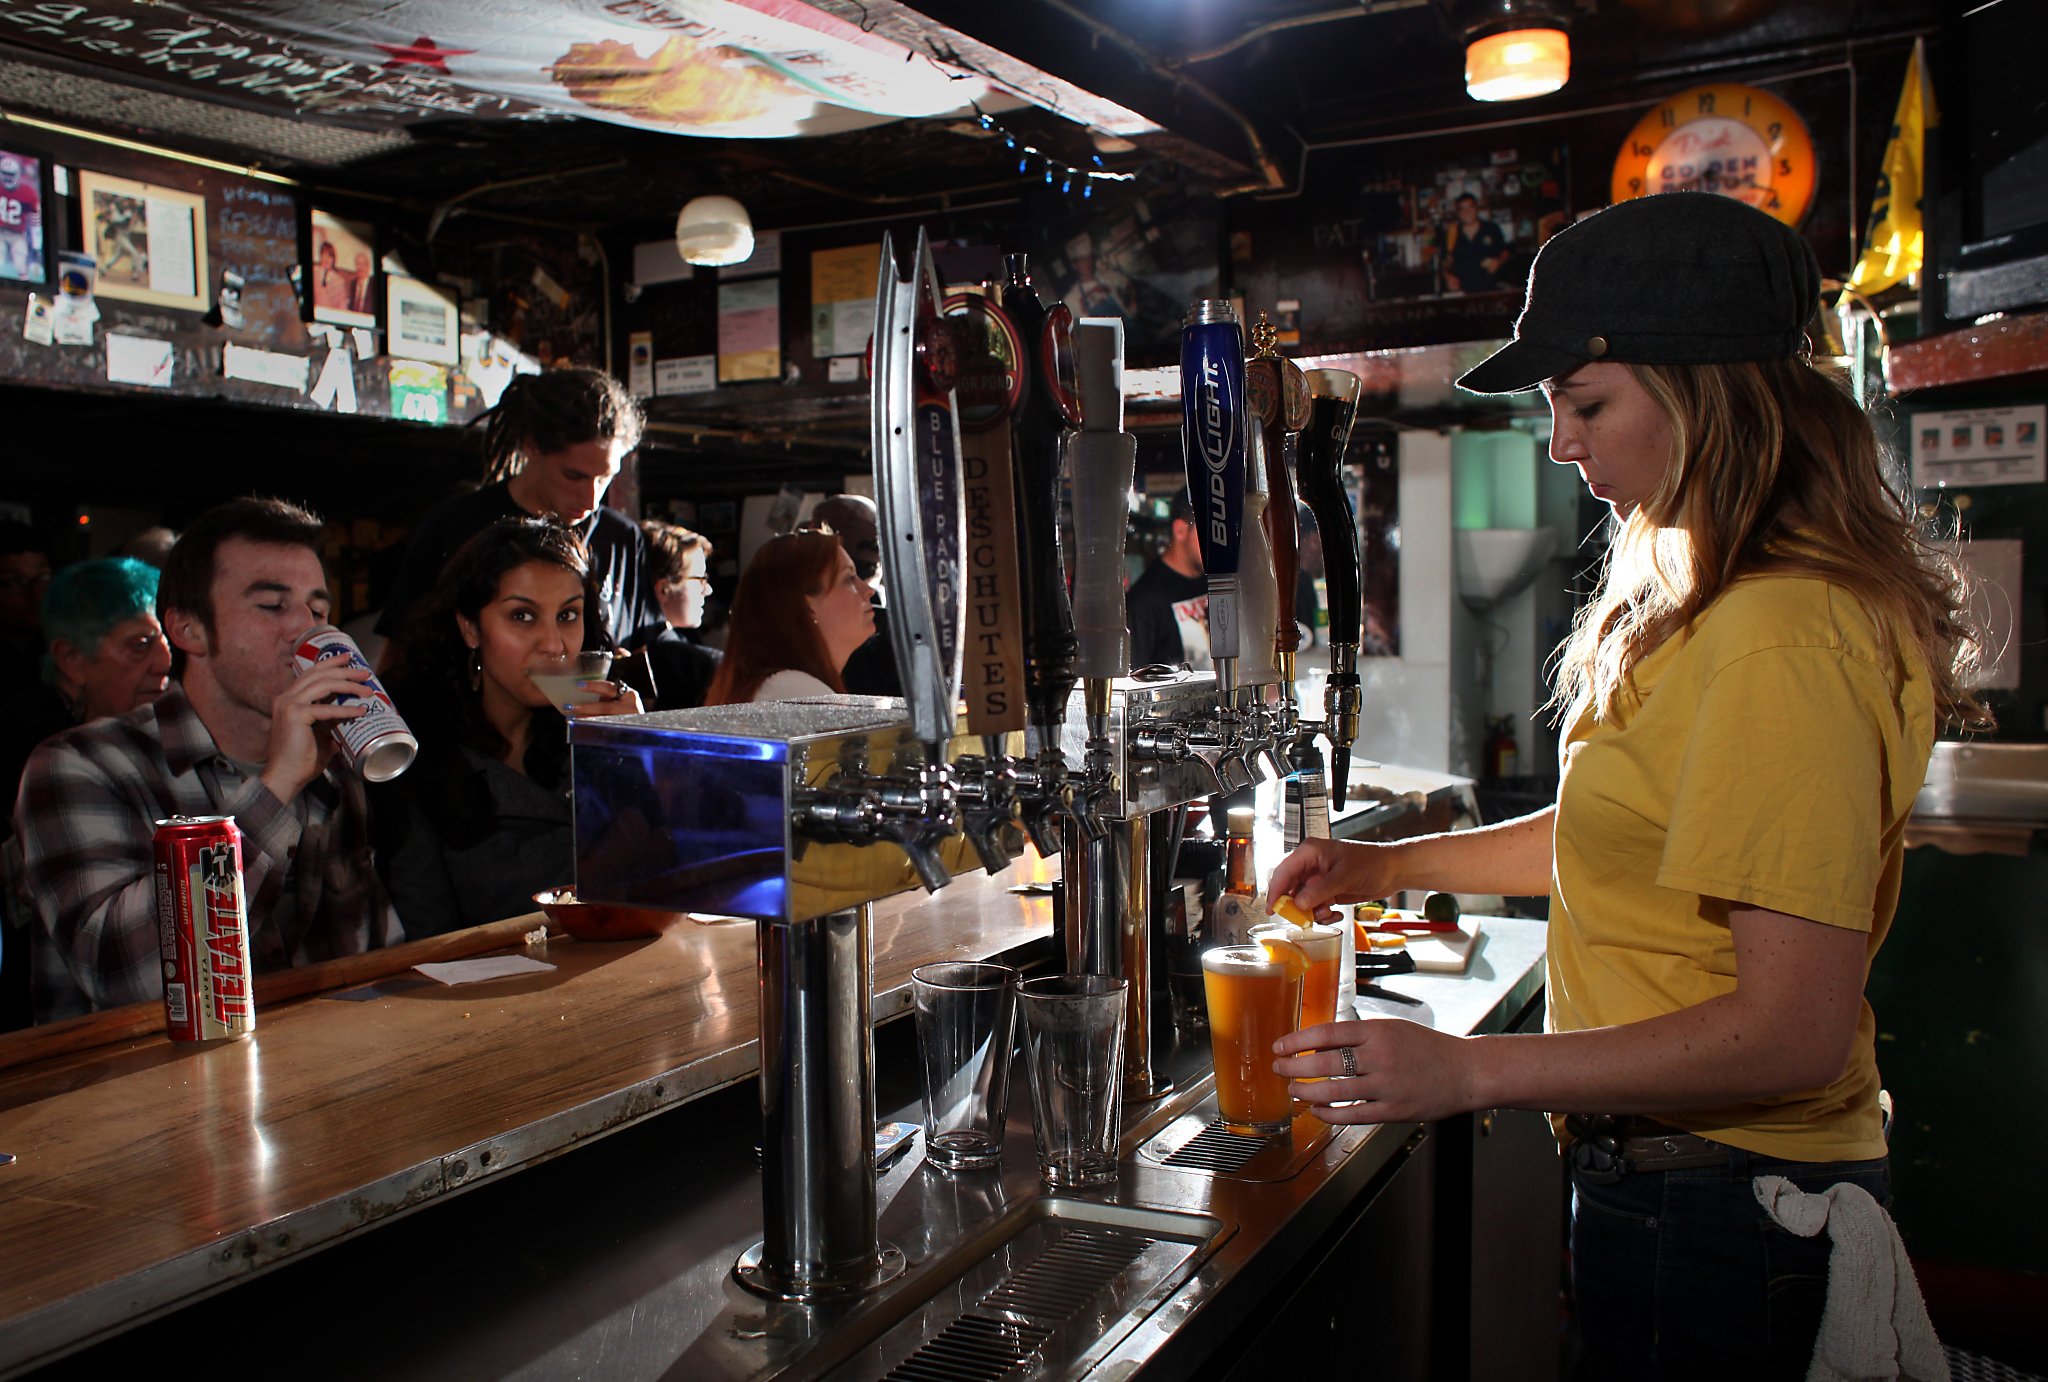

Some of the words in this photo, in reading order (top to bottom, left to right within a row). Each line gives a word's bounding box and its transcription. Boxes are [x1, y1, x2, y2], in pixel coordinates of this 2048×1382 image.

[1662, 109, 1676, 128] 11
[1699, 93, 1717, 114] 12
[1662, 157, 1757, 179] GODEN
[1203, 362, 1219, 458] LIGHT
[930, 411, 944, 499] BLUE
[1212, 474, 1227, 546] BUD
[936, 514, 952, 648] PADDLE
[966, 457, 1006, 716] DESCHUTES
[202, 957, 211, 1018] CERVEZA
[204, 885, 247, 1028] TECATE
